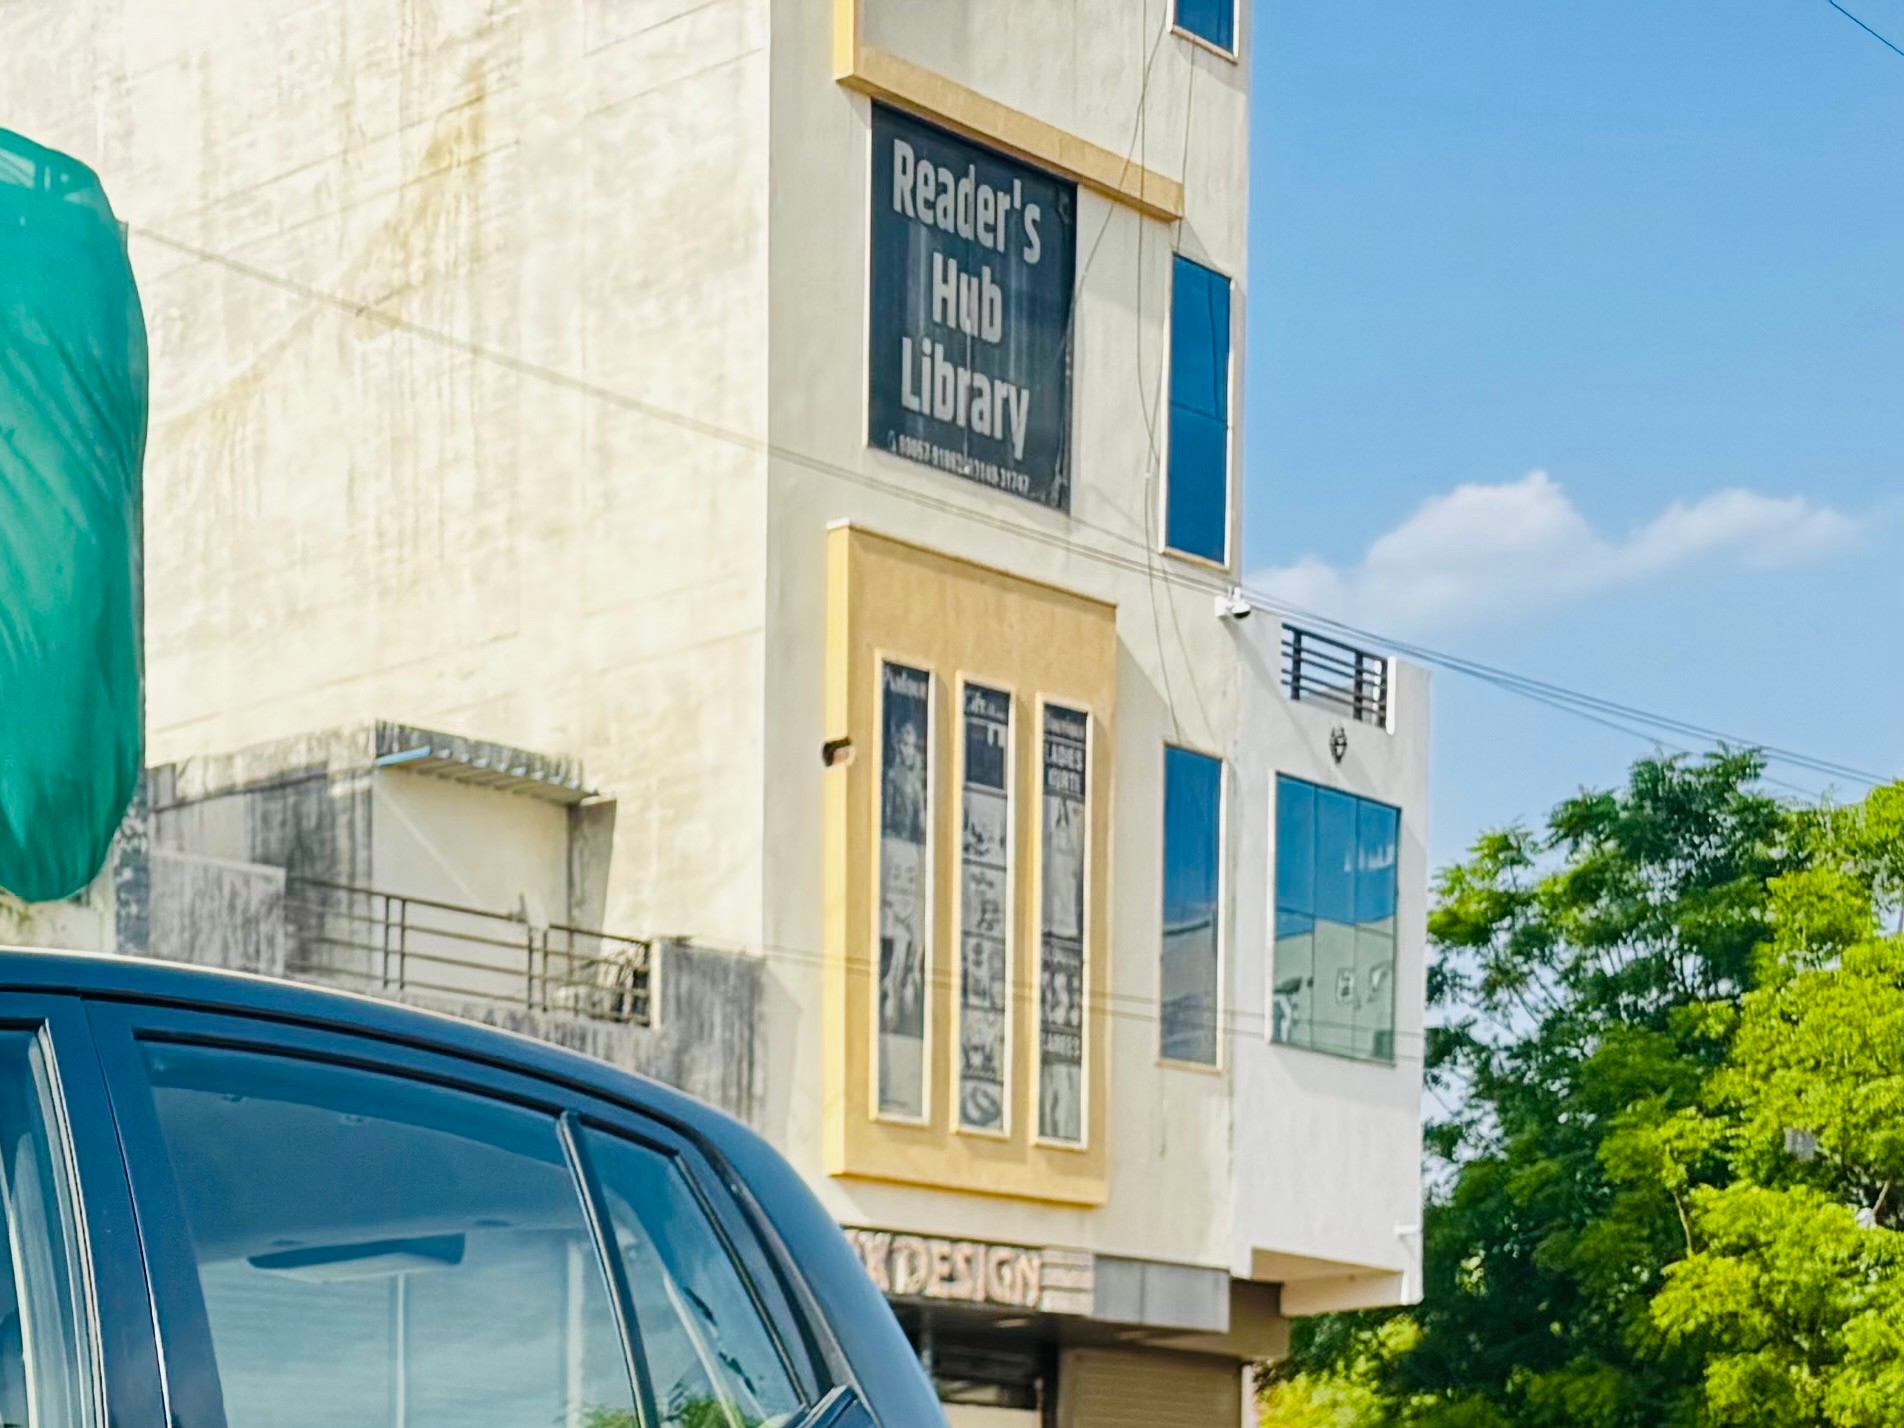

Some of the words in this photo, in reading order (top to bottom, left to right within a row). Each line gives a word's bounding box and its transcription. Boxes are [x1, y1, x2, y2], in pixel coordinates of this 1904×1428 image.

[892, 138, 1042, 266] Reader's
[931, 251, 1003, 345] Hub
[900, 336, 1031, 462] Library
[891, 1233, 1043, 1308] DESIGN
